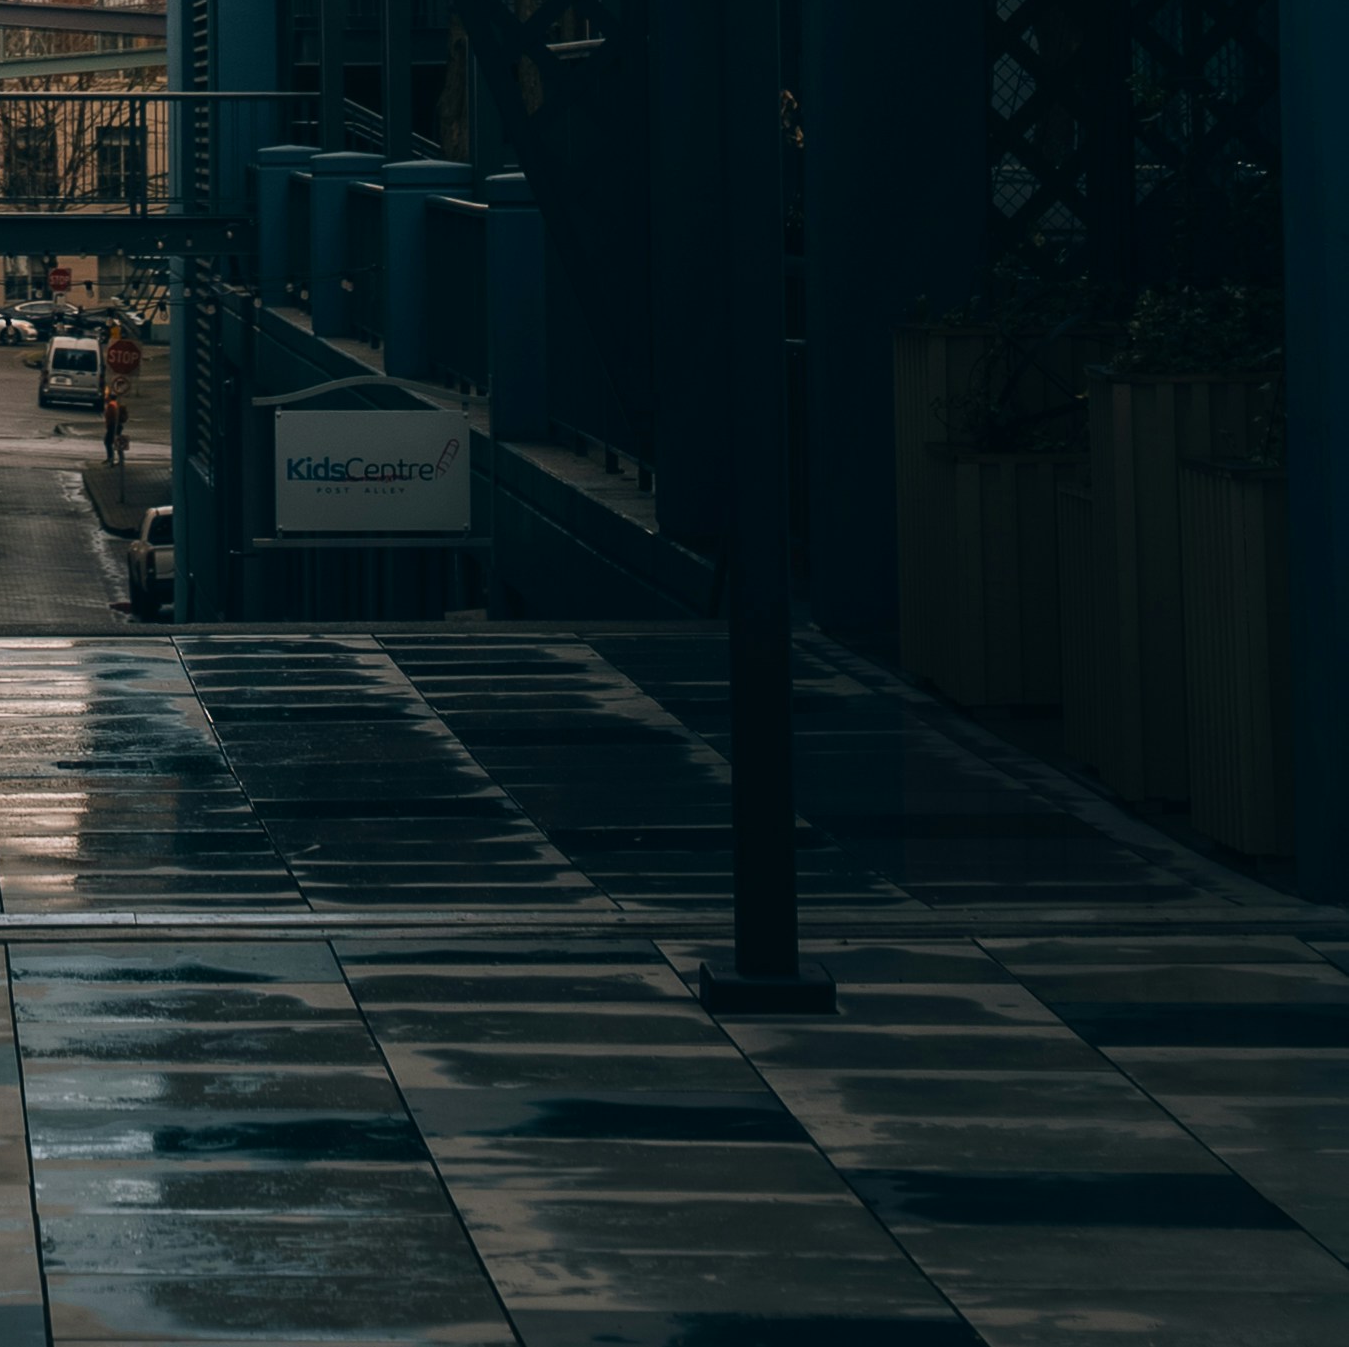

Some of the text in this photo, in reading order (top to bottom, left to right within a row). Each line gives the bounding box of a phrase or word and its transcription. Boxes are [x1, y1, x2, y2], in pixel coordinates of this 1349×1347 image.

[51, 275, 70, 285] STOP
[108, 350, 138, 364] STOP
[286, 456, 434, 482] KidsCentre
